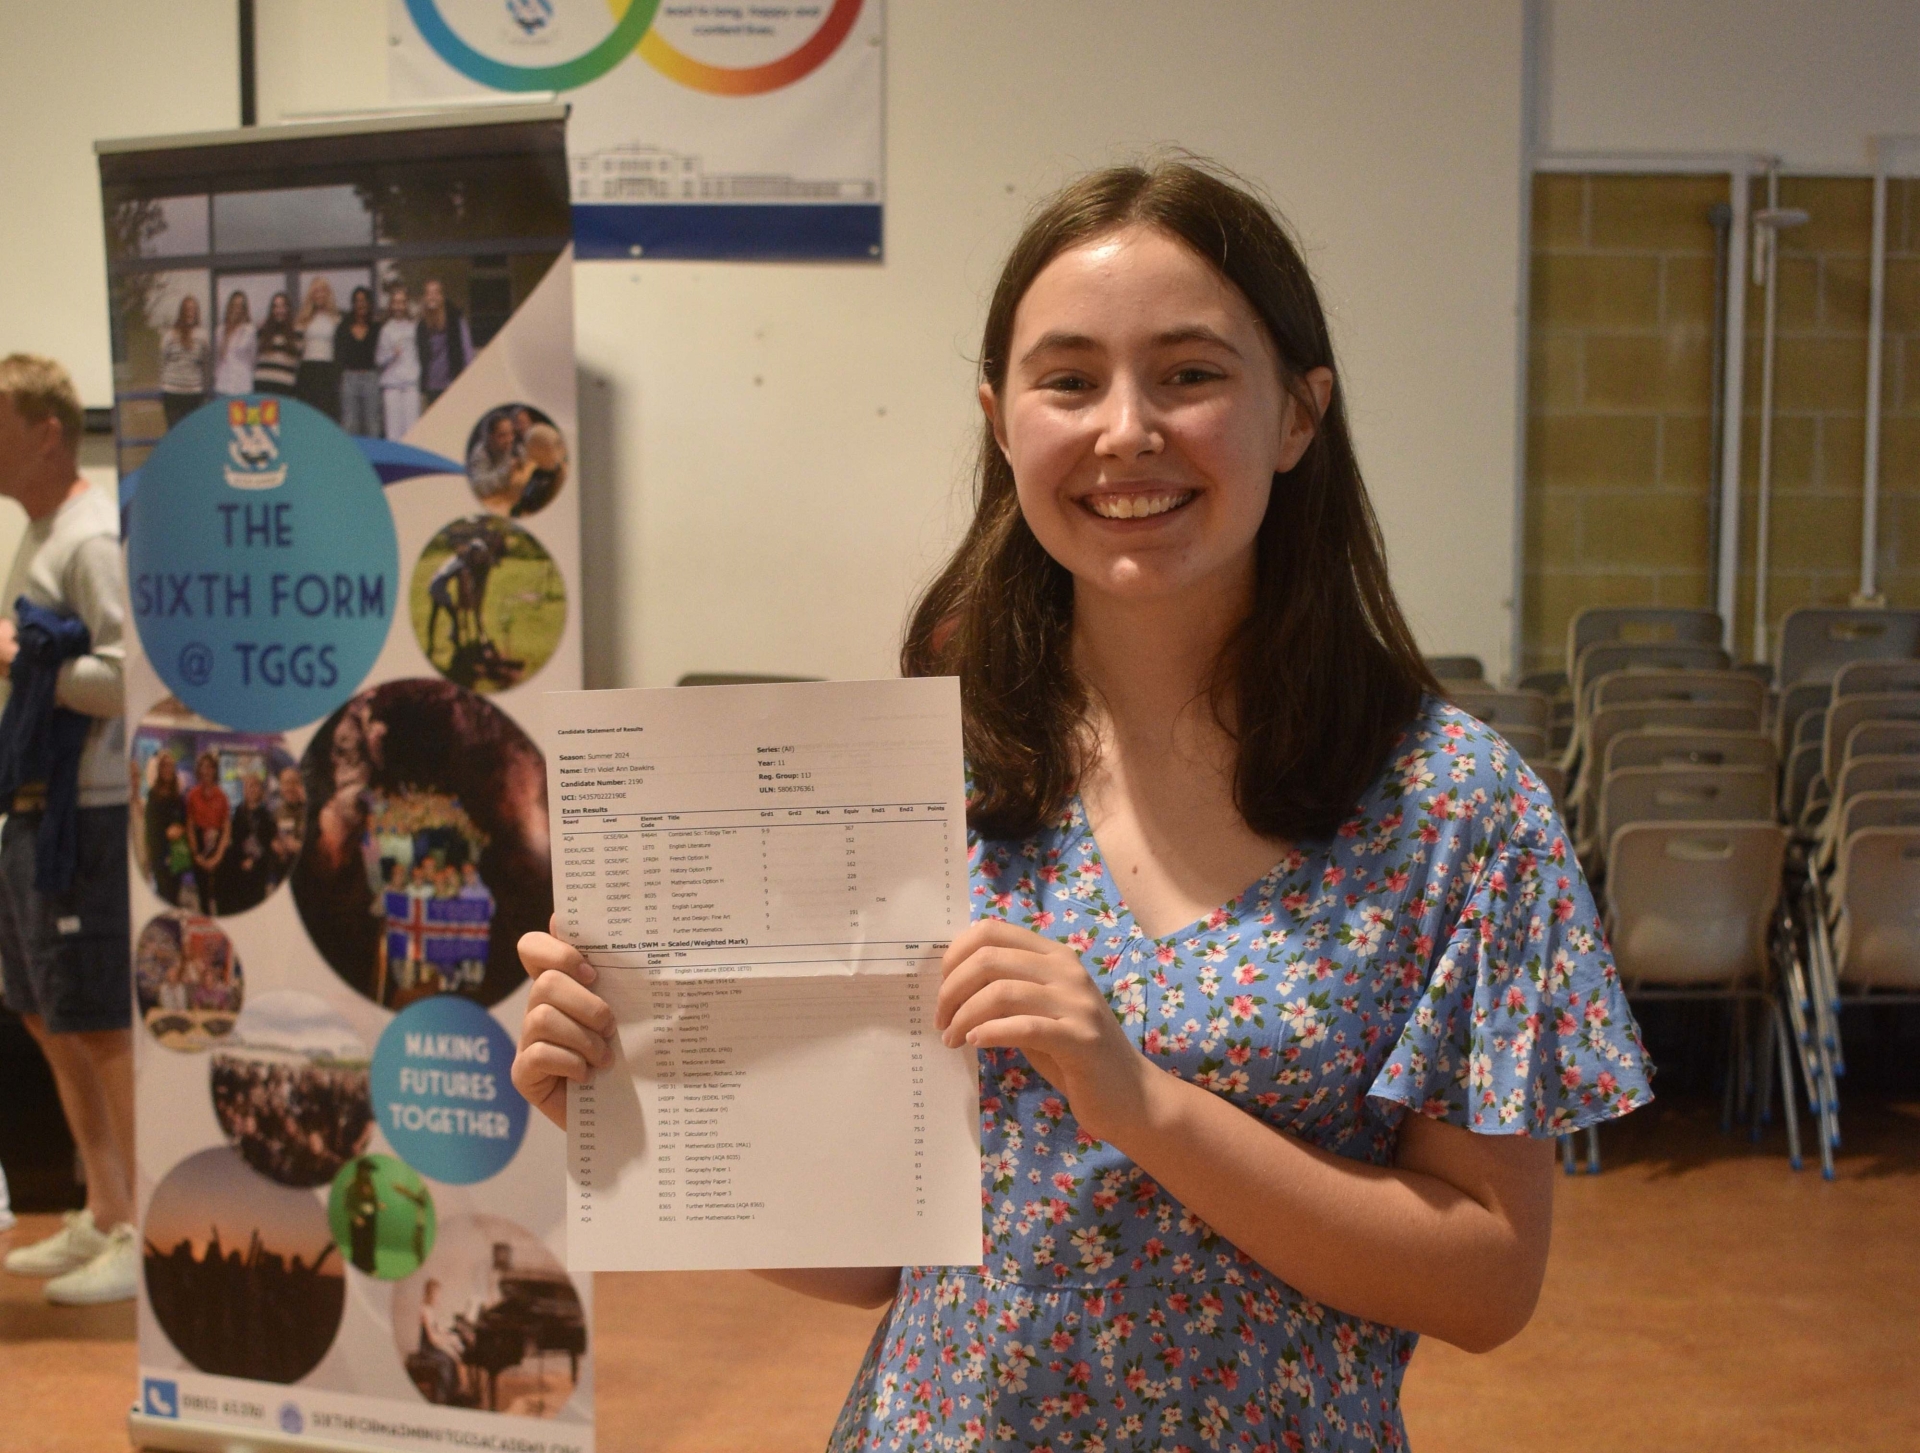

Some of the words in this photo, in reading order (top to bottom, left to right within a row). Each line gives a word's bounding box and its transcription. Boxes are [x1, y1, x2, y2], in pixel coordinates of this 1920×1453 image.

[217, 503, 293, 548] THE
[135, 573, 251, 618] SIXTH
[270, 573, 386, 618] FORM
[178, 641, 215, 687] @
[233, 643, 338, 689] TGGS
[560, 780, 595, 788] Candidate
[758, 773, 774, 781] Reg.
[775, 772, 799, 780] Group:
[668, 939, 726, 948] Scaled/Weighted
[728, 938, 748, 946] Mark)
[405, 1033, 490, 1064] MAKING
[401, 1067, 497, 1101] FUTURES
[389, 1102, 511, 1140] TOGETHER
